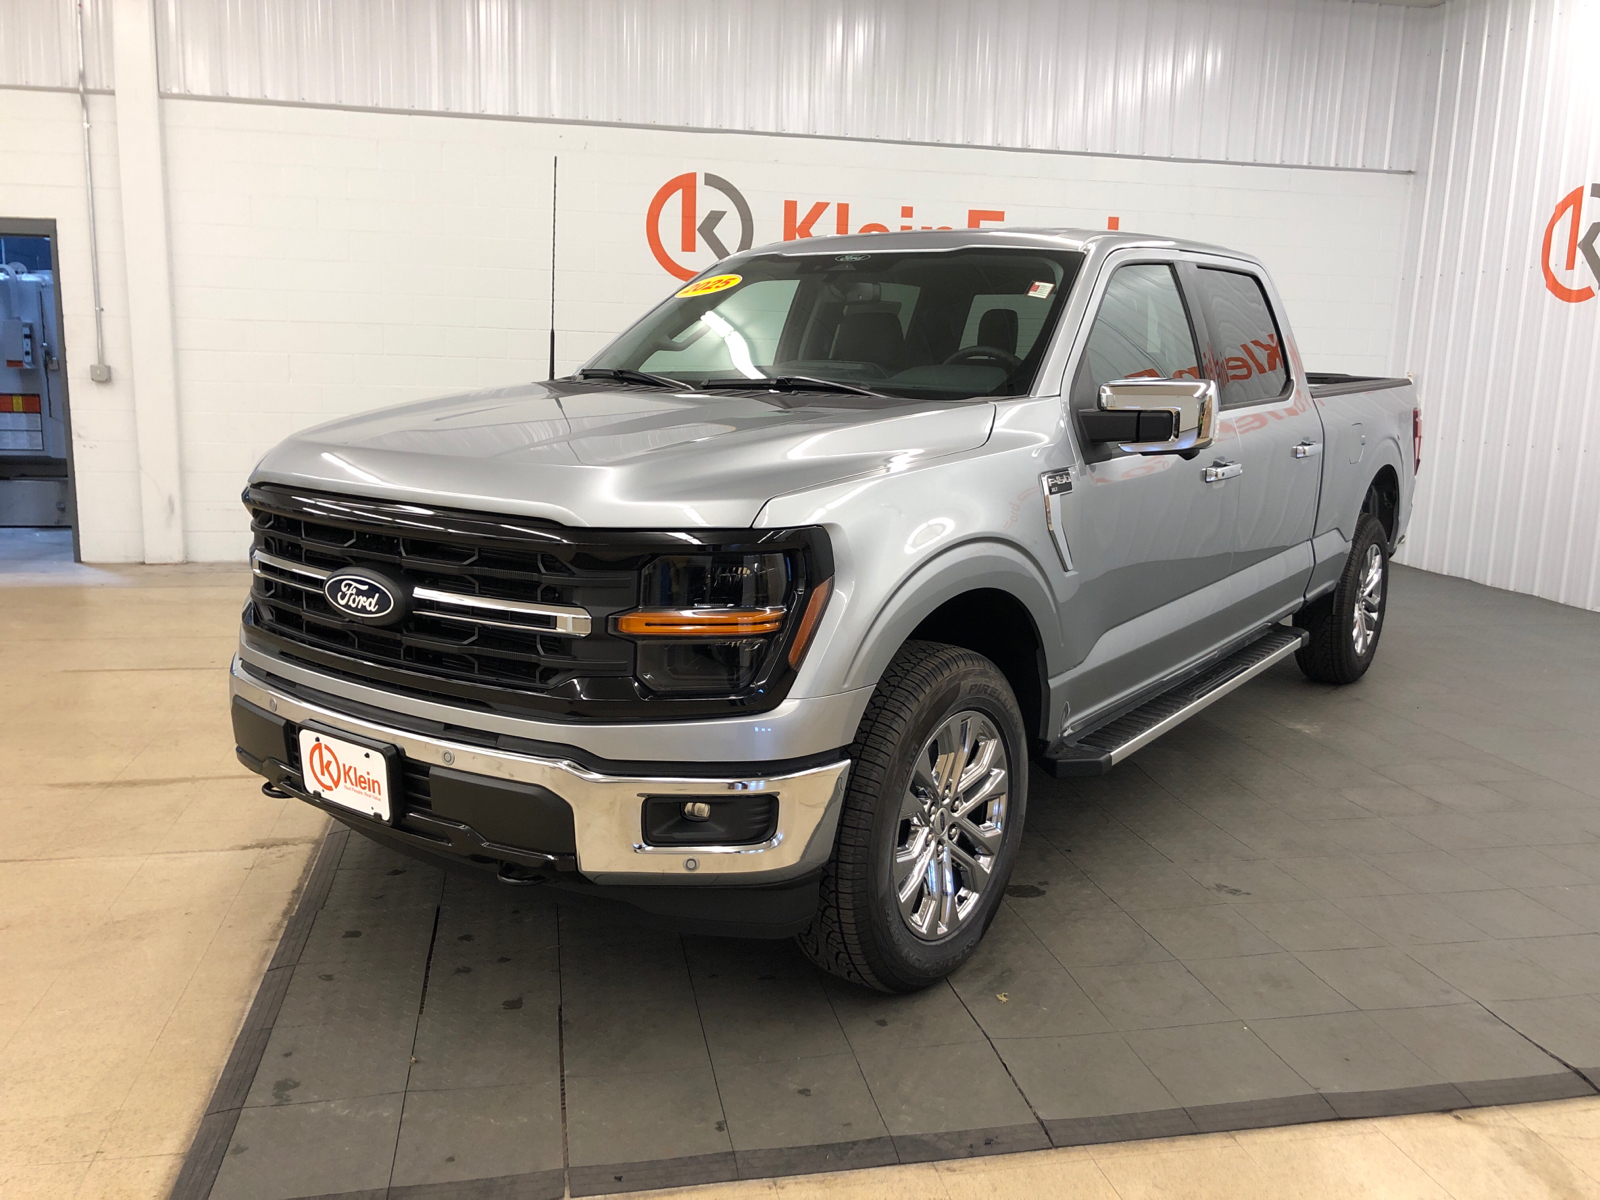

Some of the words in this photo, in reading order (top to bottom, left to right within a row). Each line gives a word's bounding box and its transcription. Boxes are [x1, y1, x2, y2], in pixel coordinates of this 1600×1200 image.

[679, 277, 738, 295] 2025
[337, 580, 379, 612] Ford
[343, 763, 381, 795] Klein
